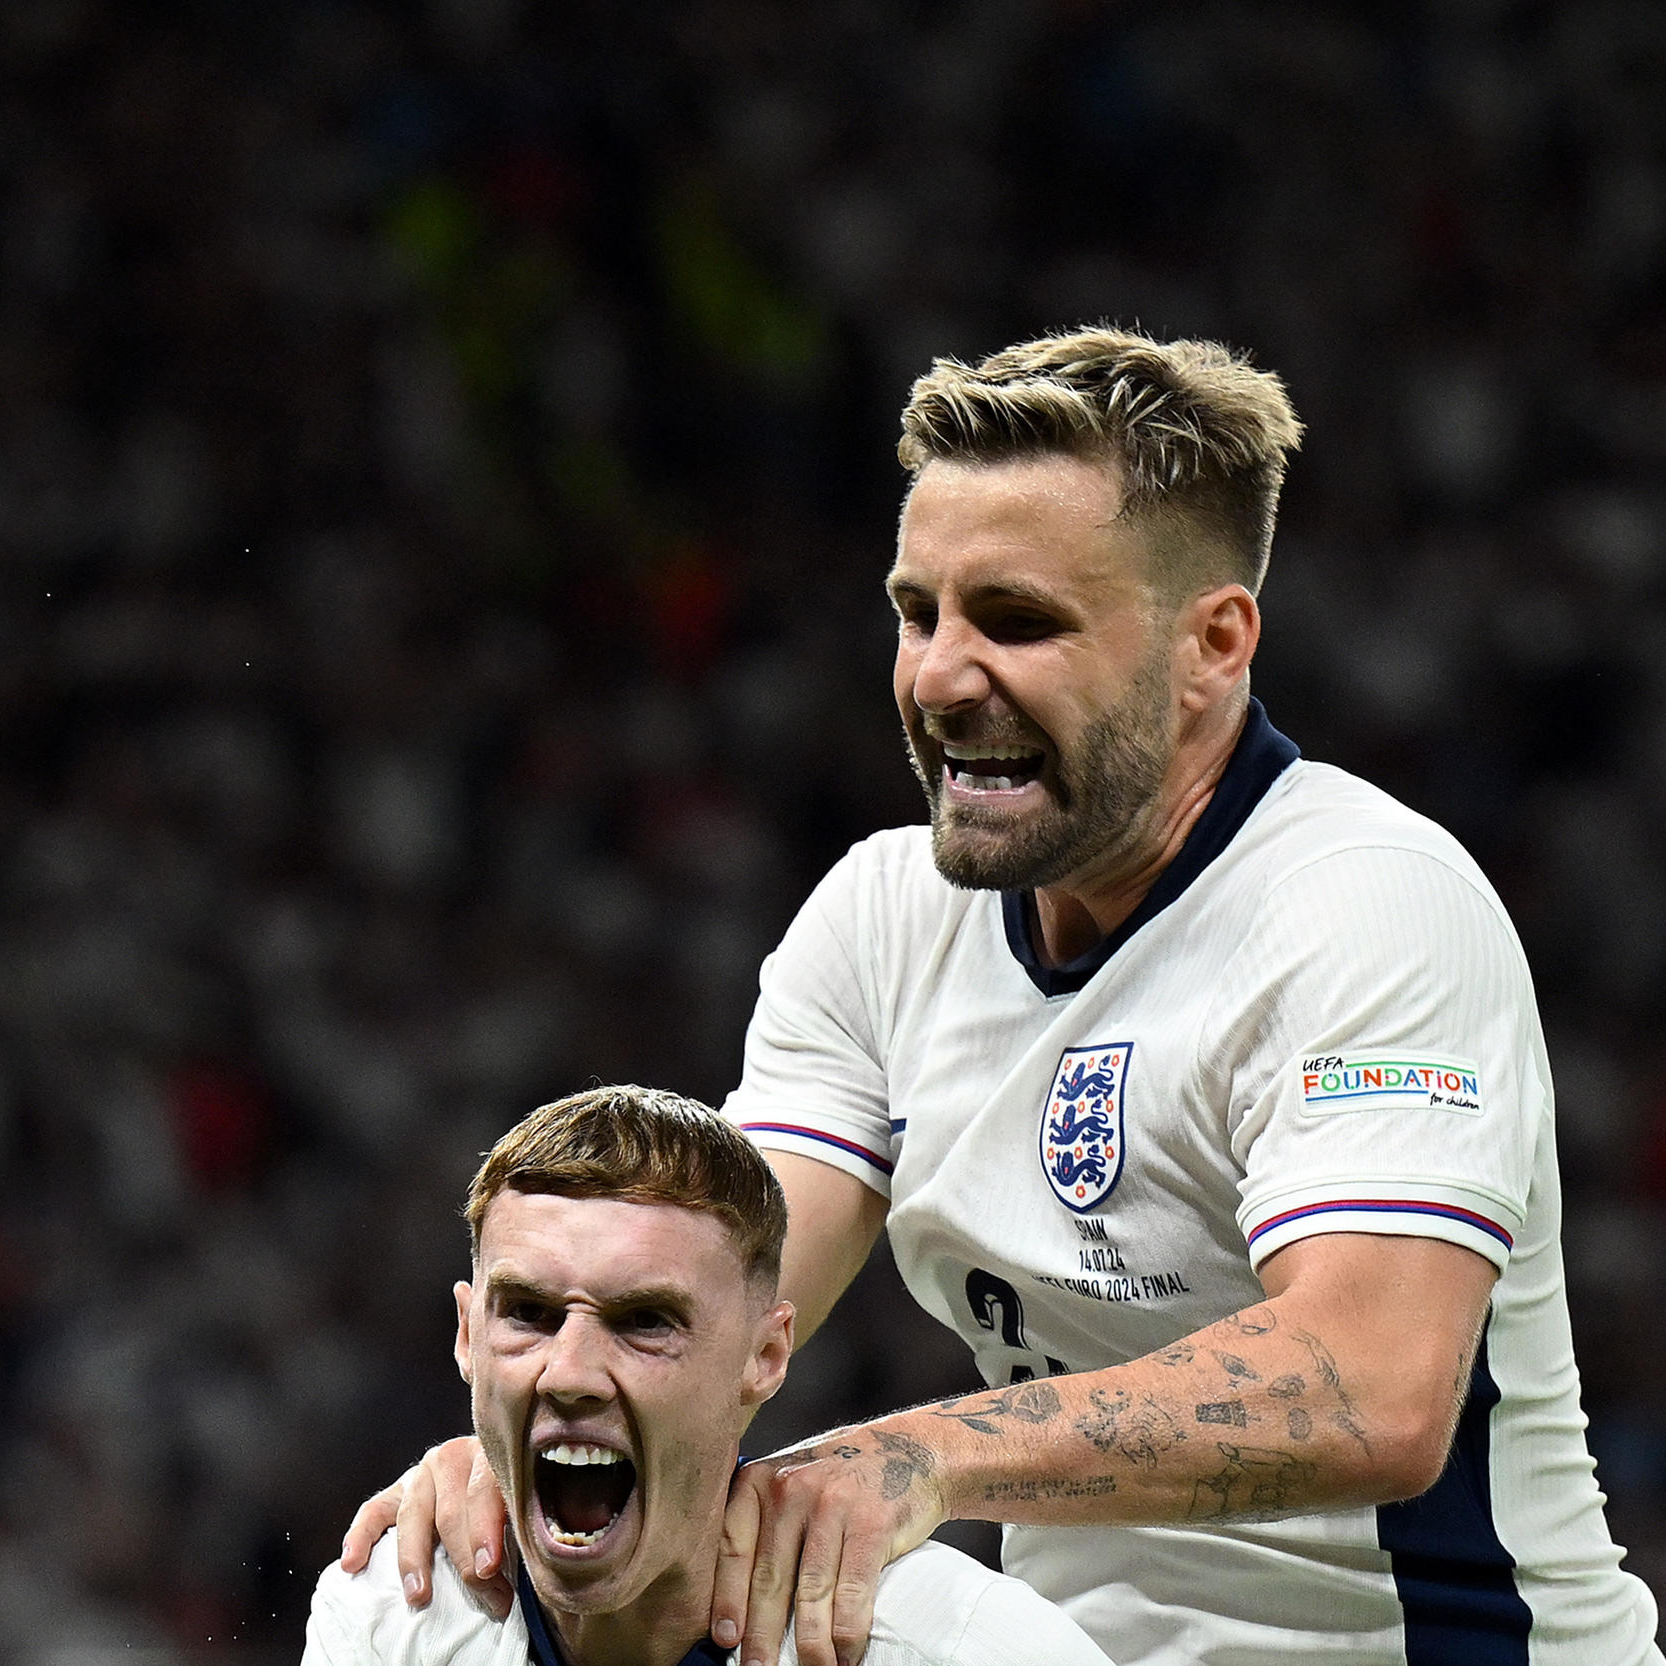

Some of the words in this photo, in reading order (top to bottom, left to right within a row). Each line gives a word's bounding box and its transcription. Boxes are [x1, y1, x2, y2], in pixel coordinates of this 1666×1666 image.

[1303, 1057, 1345, 1072] UEFA
[1303, 1068, 1478, 1096] FOUNDATION
[1430, 1092, 1443, 1106] for
[1446, 1095, 1480, 1110] children
[1105, 1276, 1140, 1302] 2024
[1141, 1271, 1190, 1299] FINAL
